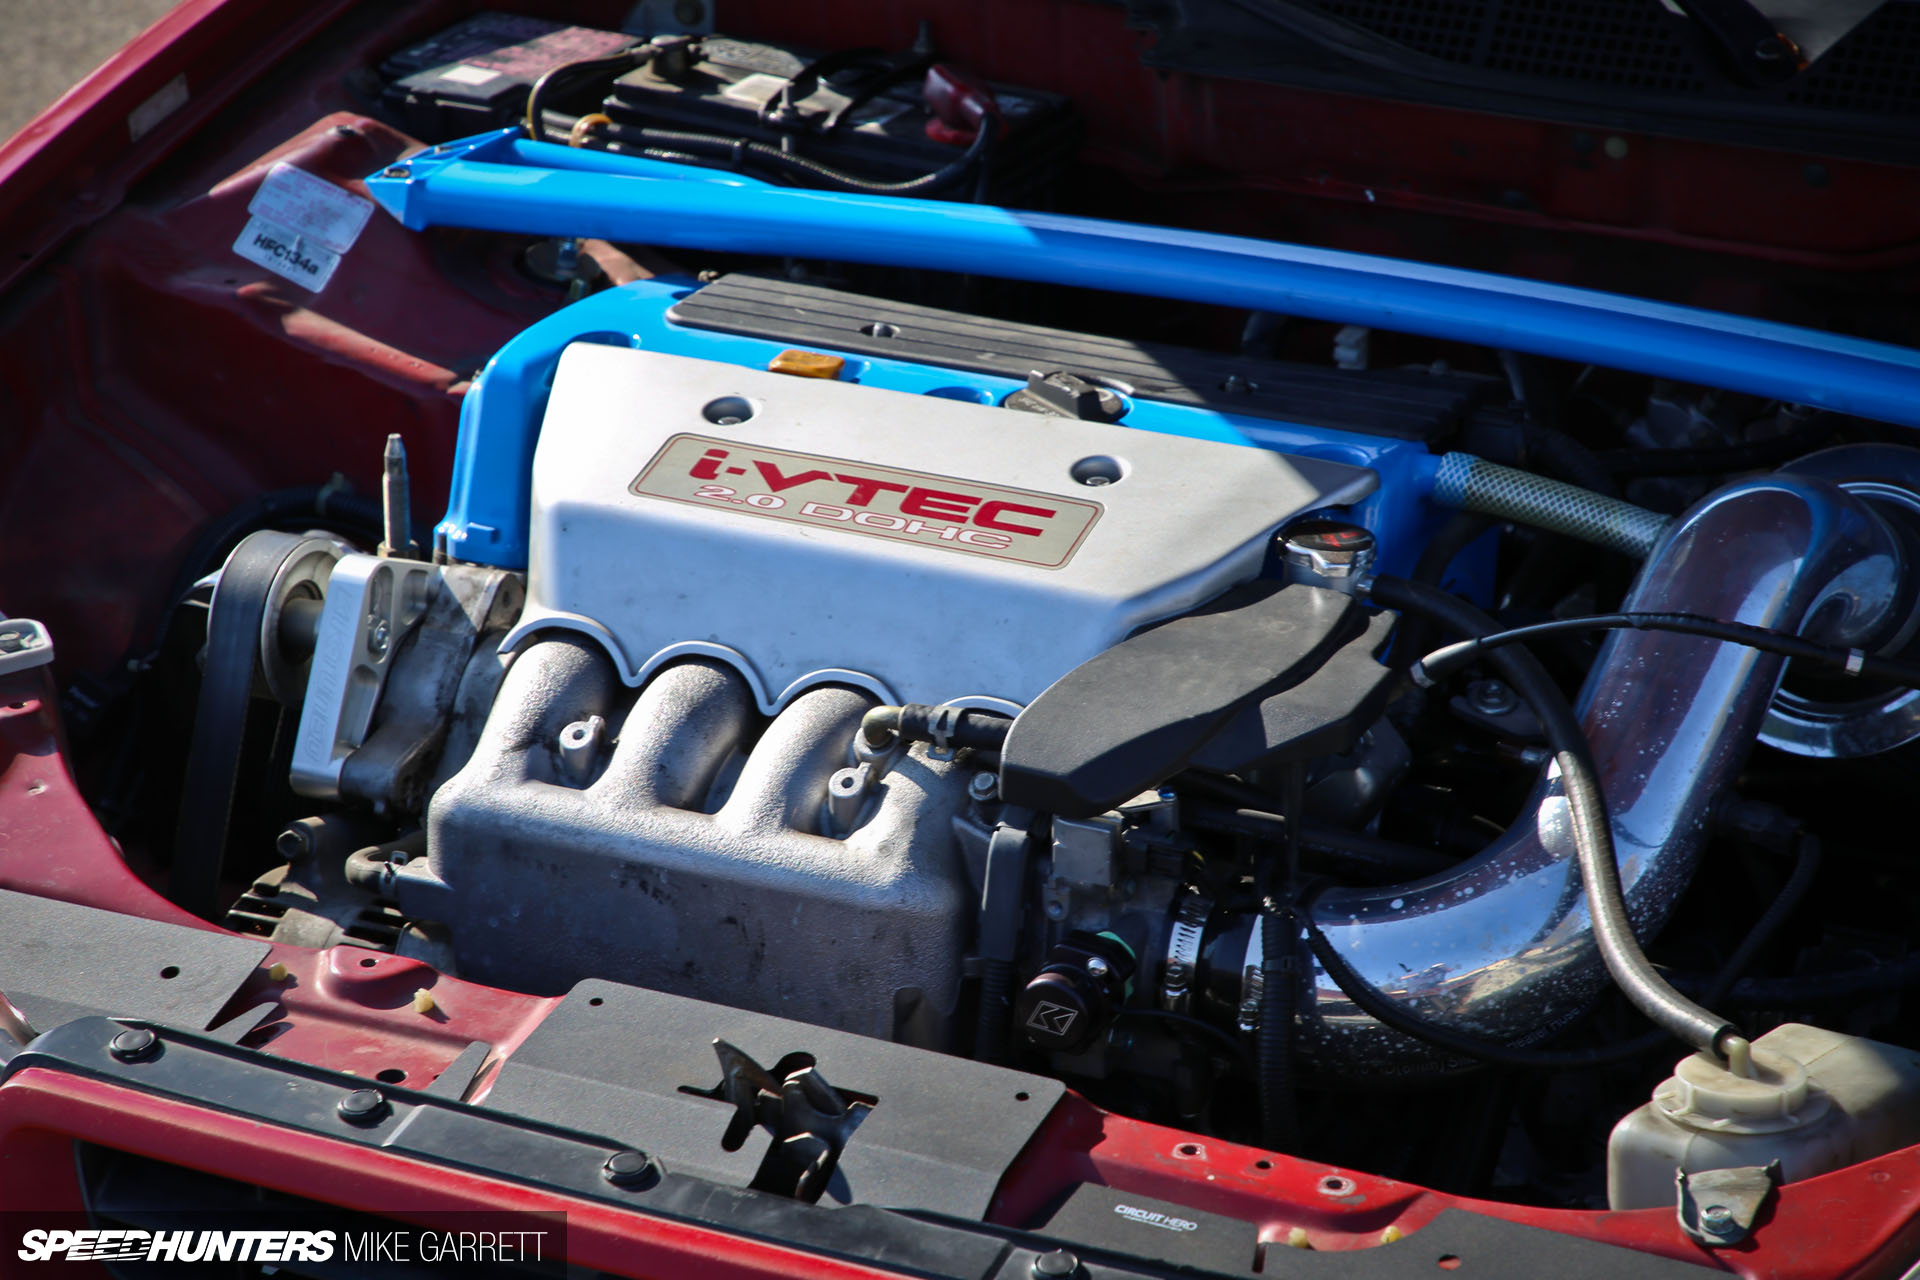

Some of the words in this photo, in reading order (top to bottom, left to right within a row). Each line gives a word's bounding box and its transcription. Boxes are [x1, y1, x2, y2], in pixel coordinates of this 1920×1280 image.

[253, 233, 320, 276] HFC134a
[688, 448, 1057, 538] i-VTEC
[693, 484, 786, 511] 2.0
[799, 501, 1013, 550] DOHC
[1113, 1204, 1165, 1222] CIRCUIT
[1162, 1215, 1199, 1231] HERO
